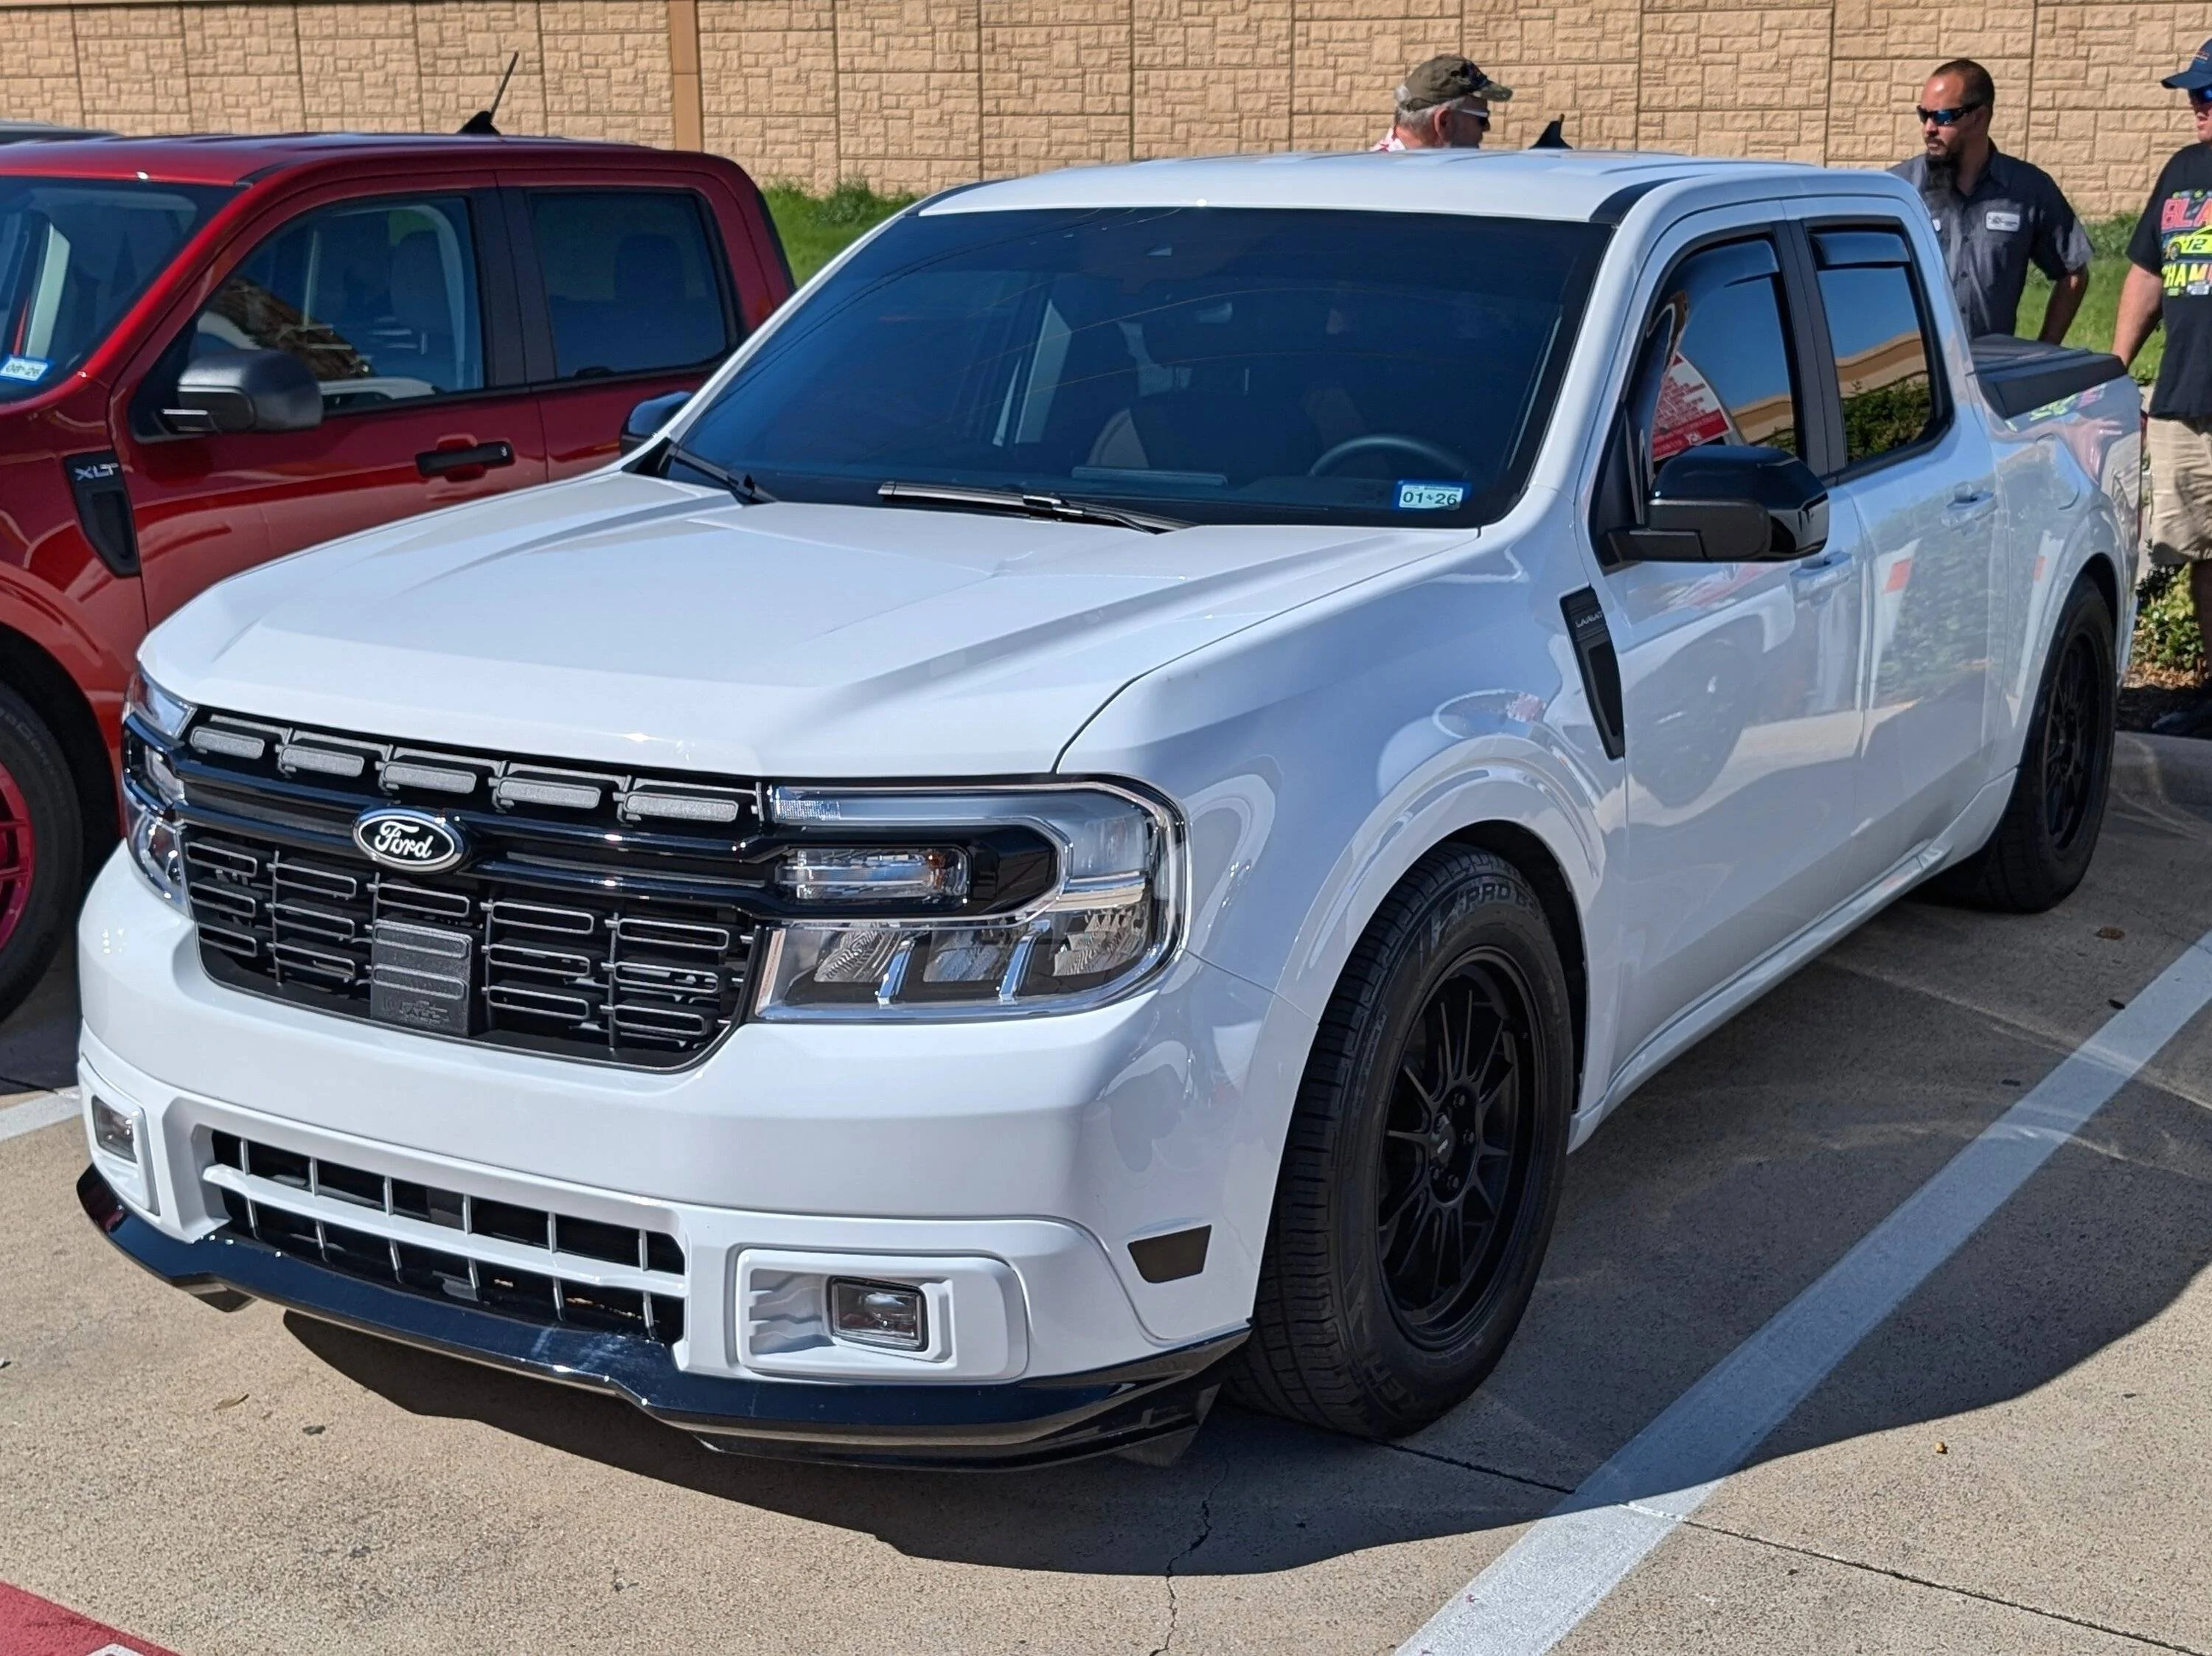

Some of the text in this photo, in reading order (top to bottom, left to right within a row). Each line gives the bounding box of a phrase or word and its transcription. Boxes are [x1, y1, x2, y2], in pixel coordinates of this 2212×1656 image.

[2185, 238, 2208, 251] 12
[74, 462, 119, 481] XLT
[374, 820, 434, 859] Ford
